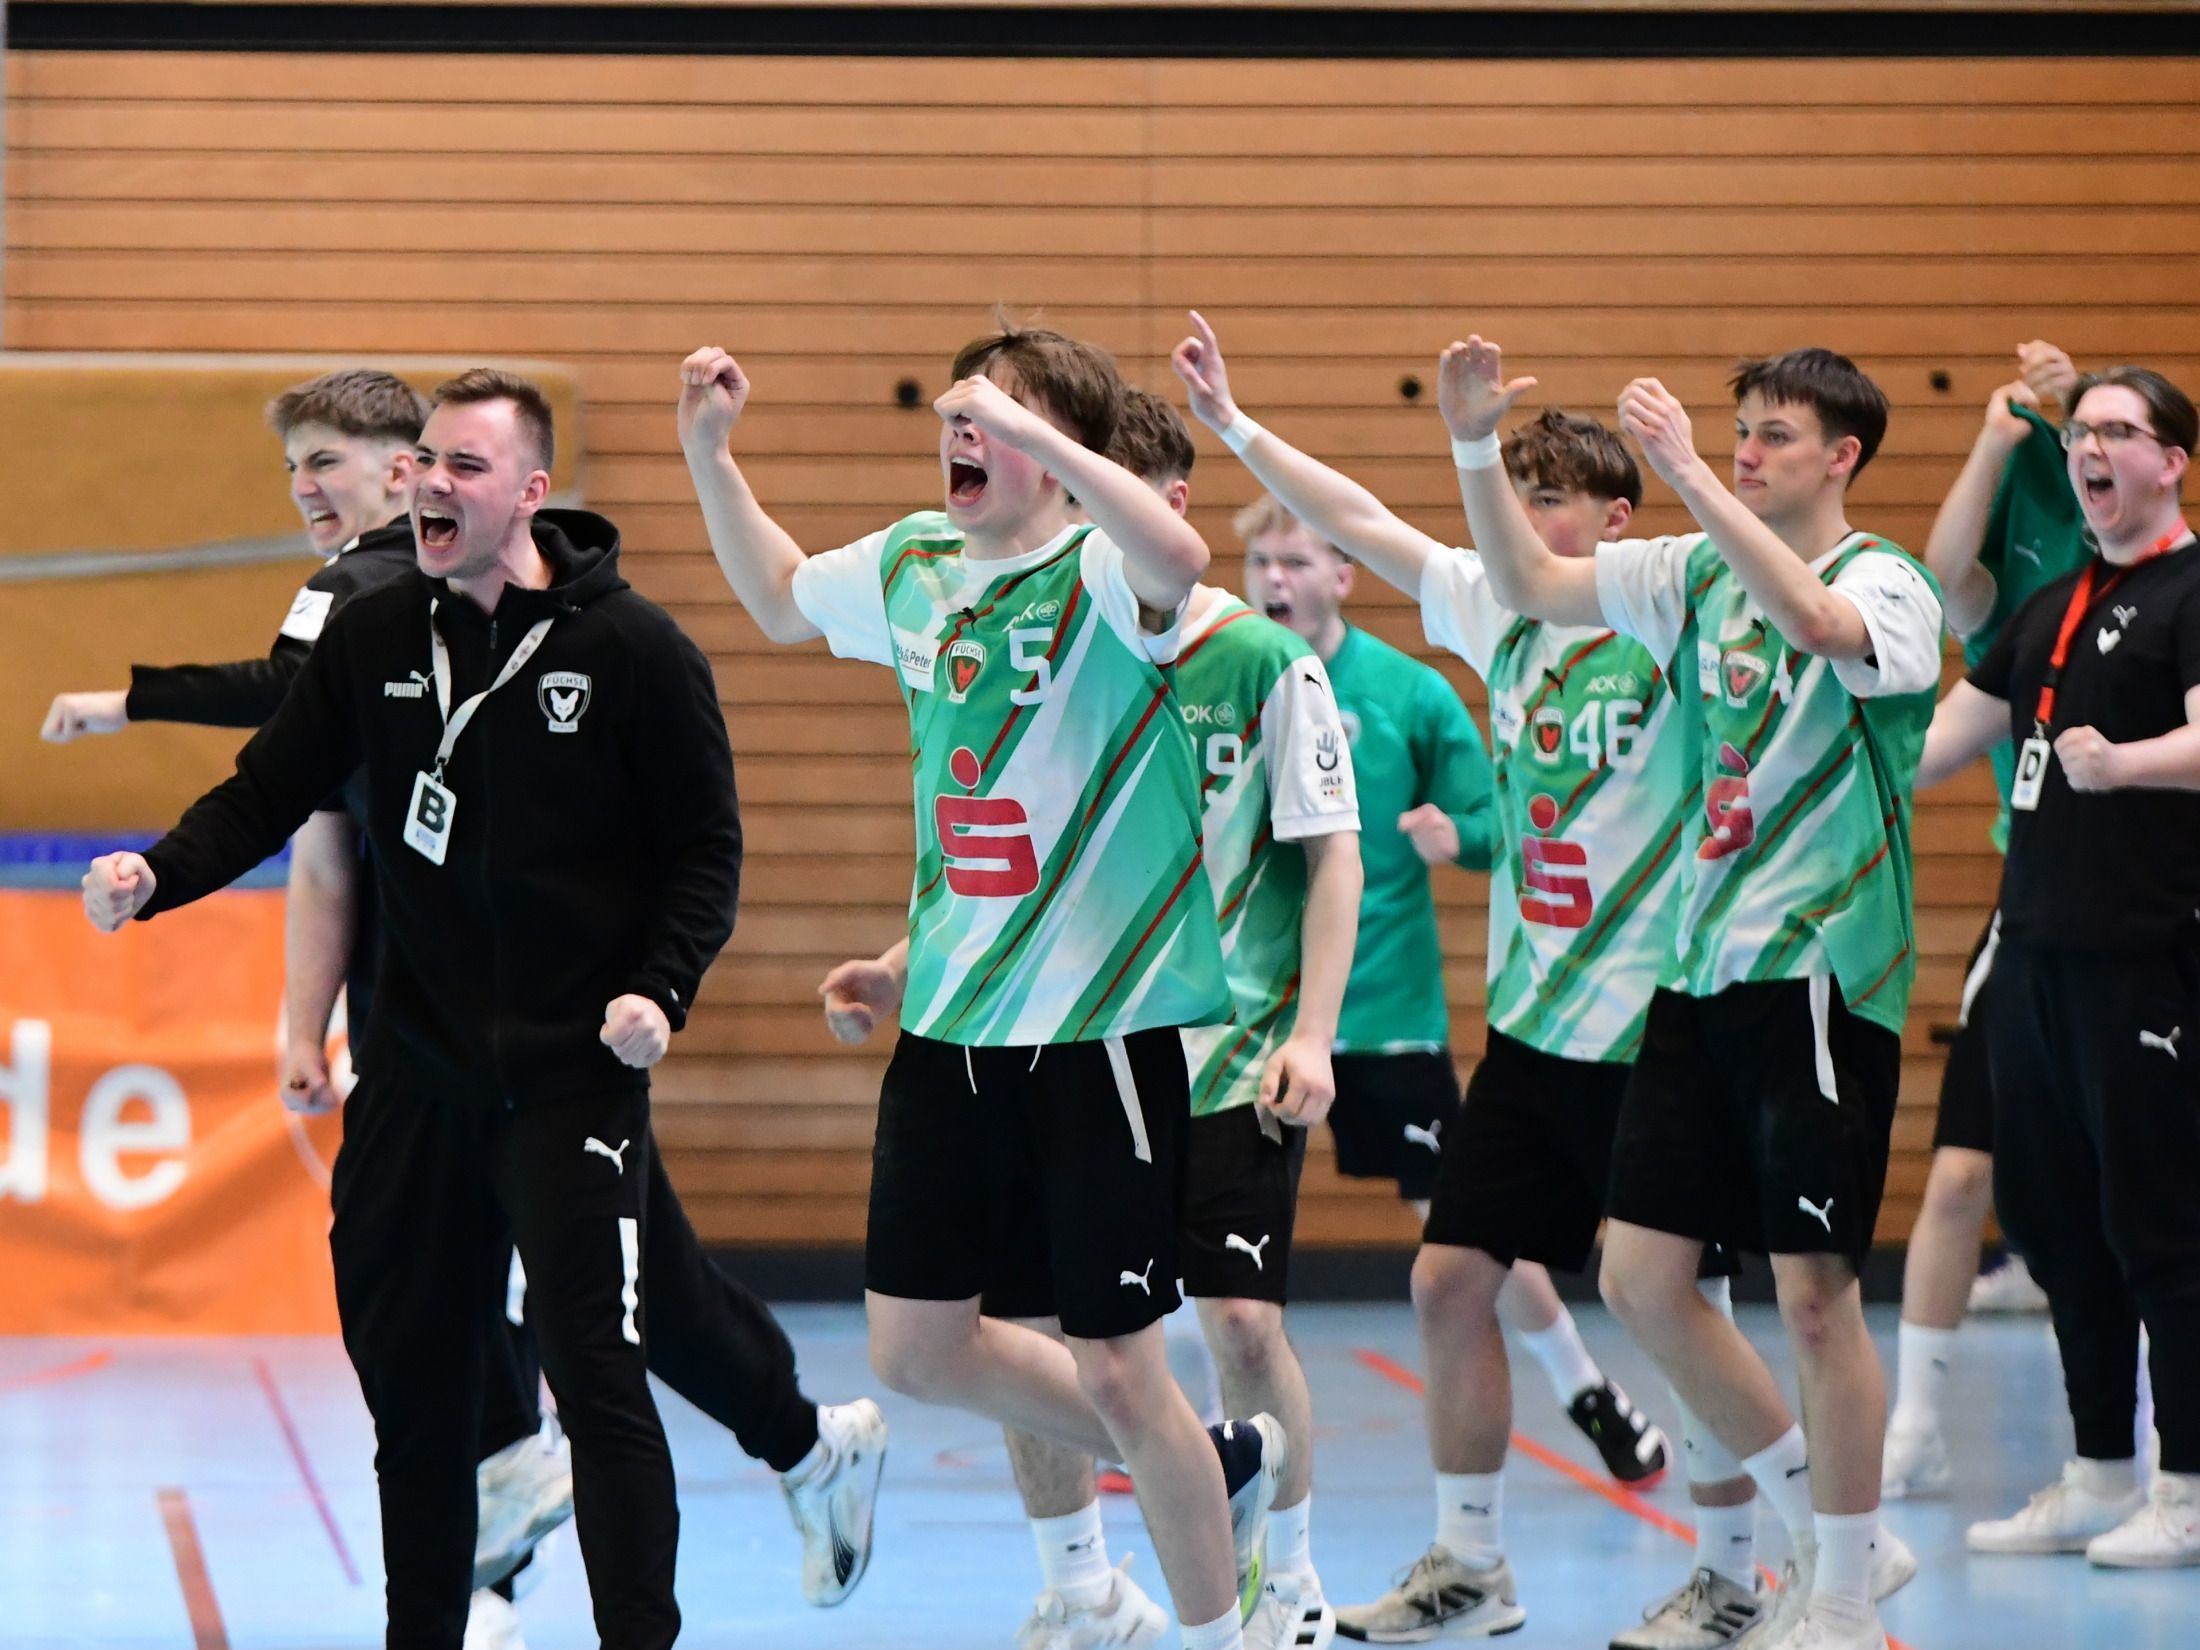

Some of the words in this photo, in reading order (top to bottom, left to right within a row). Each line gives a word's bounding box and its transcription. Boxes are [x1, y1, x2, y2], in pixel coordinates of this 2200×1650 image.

[384, 682, 423, 698] PUMA
[1009, 627, 1053, 706] 5
[1179, 704, 1213, 724] OK
[1569, 699, 1643, 772] 46
[1189, 731, 1243, 807] 9
[417, 782, 447, 834] B
